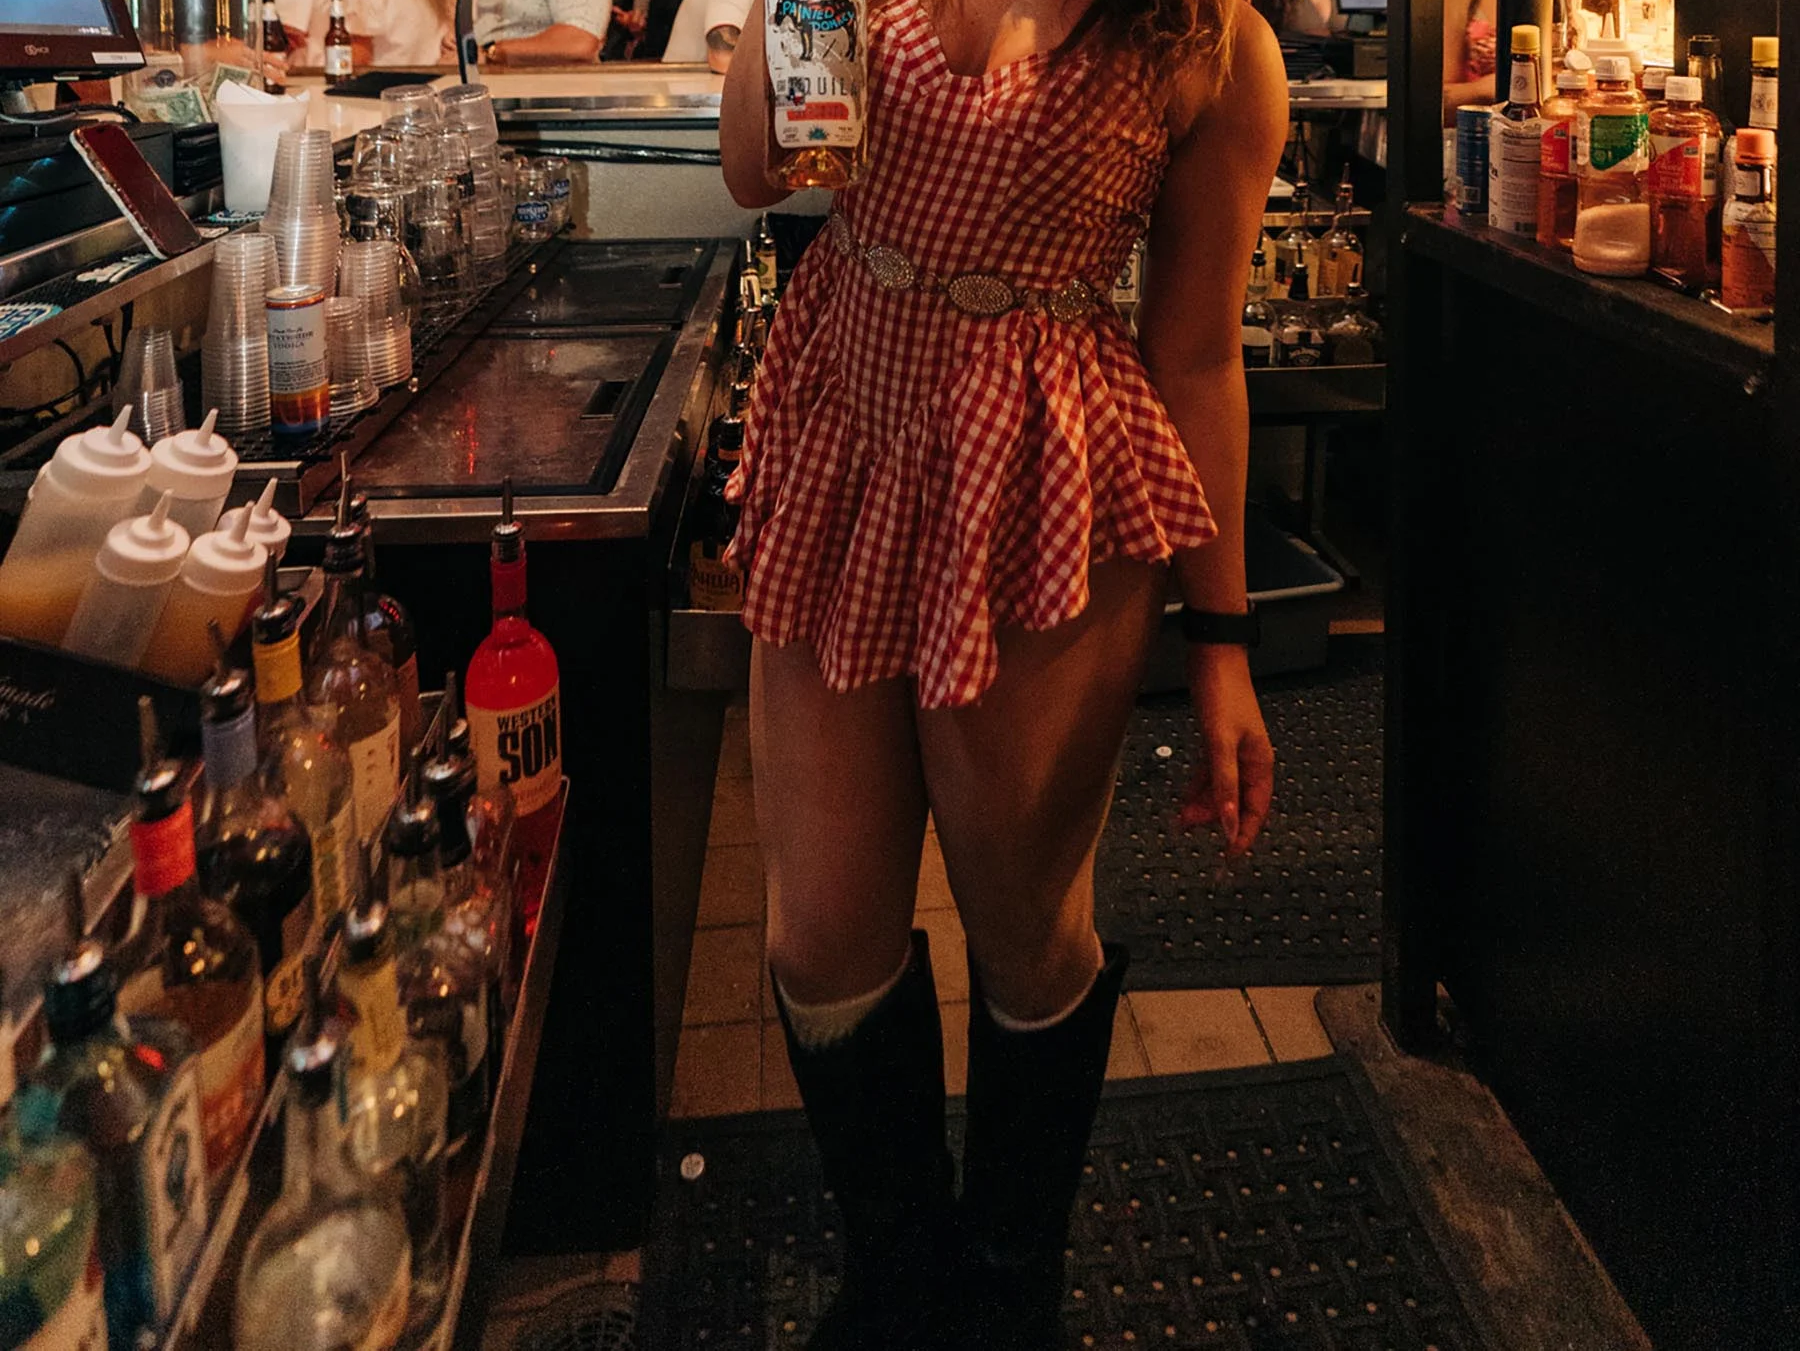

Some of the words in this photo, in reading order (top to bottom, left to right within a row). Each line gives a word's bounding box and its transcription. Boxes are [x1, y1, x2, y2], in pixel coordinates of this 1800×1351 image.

[781, 0, 835, 21] PAINTED
[496, 695, 556, 731] WESTERN
[497, 716, 558, 785] SON
